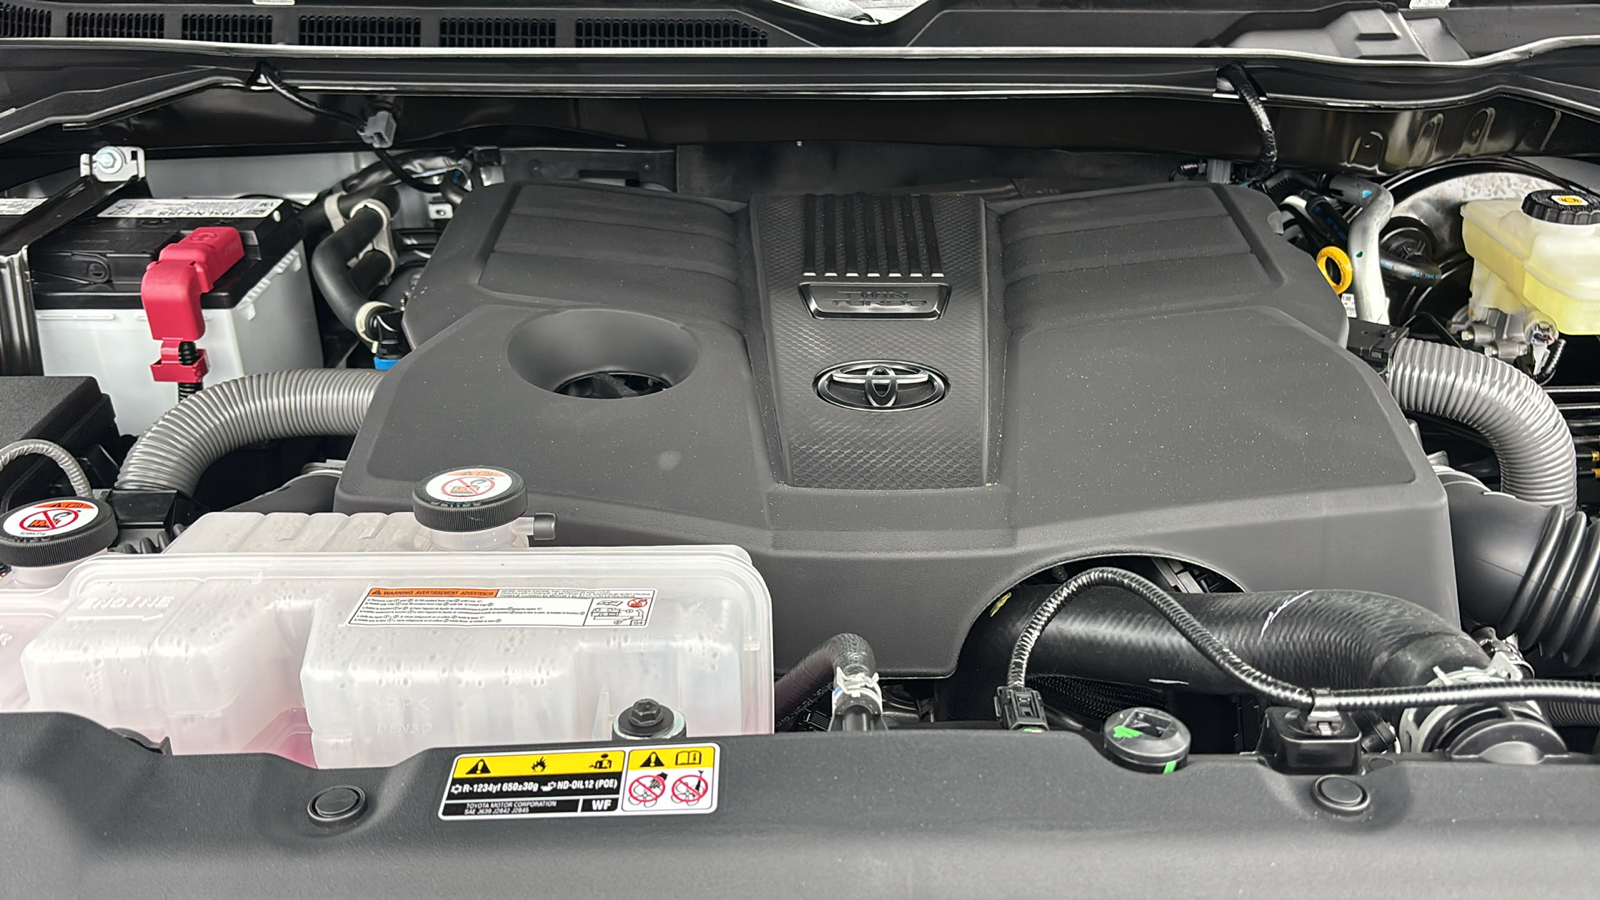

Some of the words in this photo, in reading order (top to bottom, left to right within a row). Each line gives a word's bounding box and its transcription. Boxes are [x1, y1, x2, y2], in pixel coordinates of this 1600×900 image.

[77, 596, 175, 610] ENGINE
[462, 782, 501, 793] R-1234yf
[502, 781, 539, 792] 650±30g
[556, 779, 595, 790] ND-OIL12
[595, 778, 618, 790] (POE)
[513, 800, 557, 808] CORPORATION
[591, 799, 612, 811] WF
